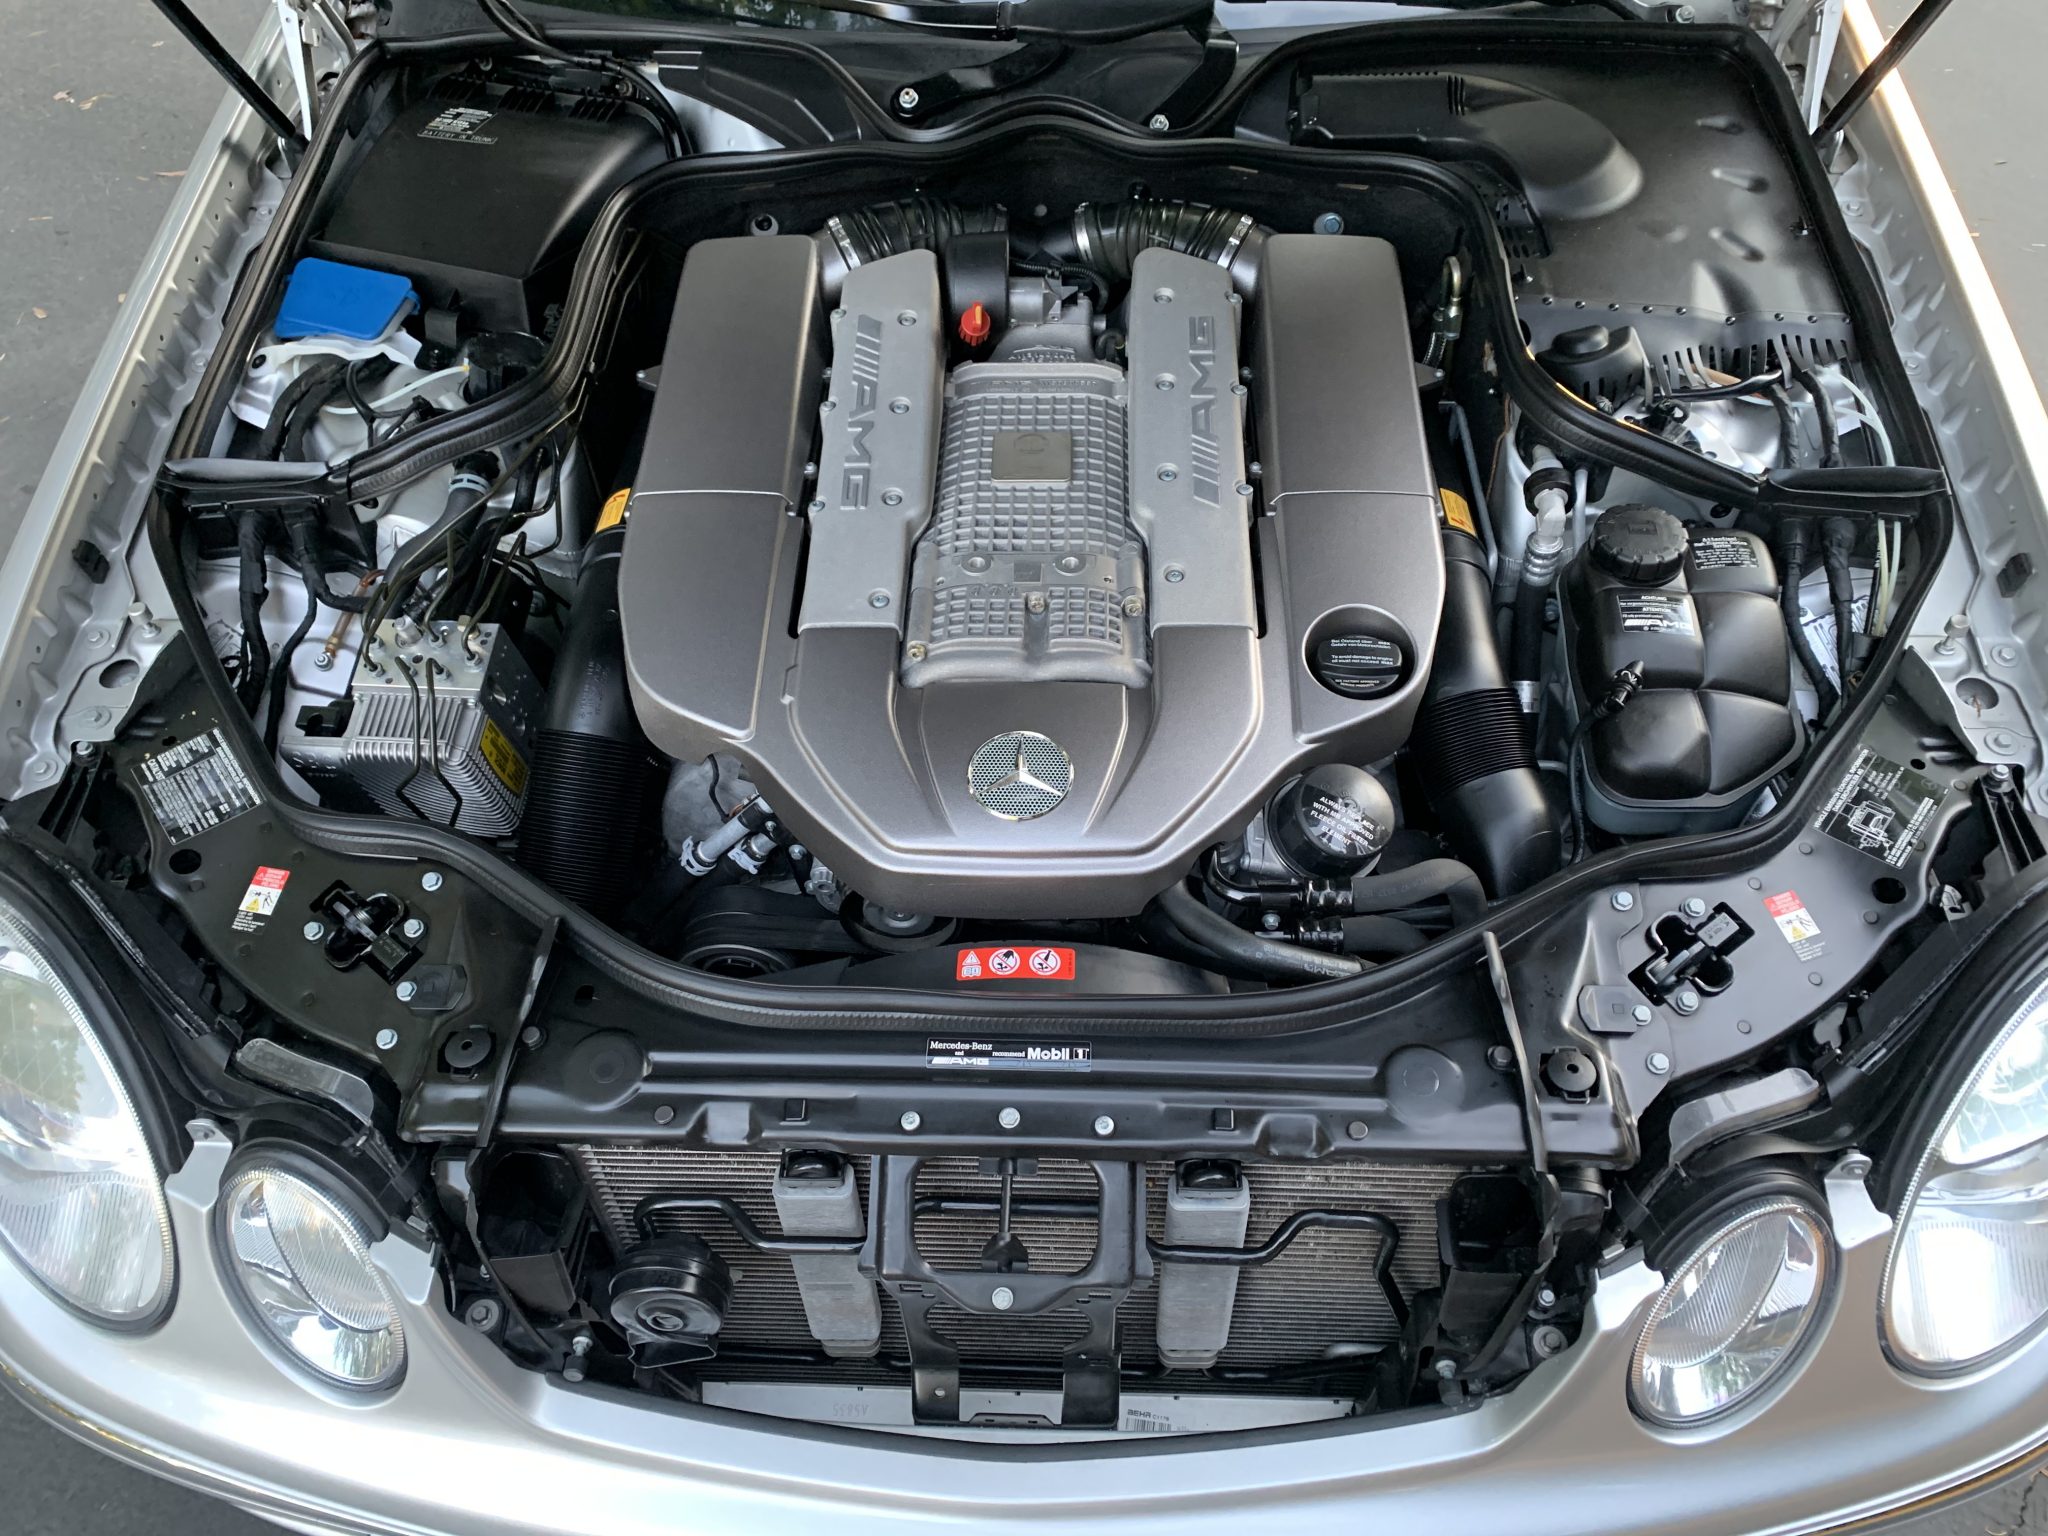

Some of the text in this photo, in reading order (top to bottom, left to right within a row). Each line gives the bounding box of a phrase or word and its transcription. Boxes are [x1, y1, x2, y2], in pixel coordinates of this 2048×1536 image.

[1189, 315, 1219, 447] AMG
[840, 374, 879, 510] AMG
[1313, 801, 1374, 840] WITH MB APPROVED
[1320, 796, 1375, 831] ALWAYS REPLACE
[1310, 810, 1369, 847] FLEECE OIL FILTER
[1321, 825, 1352, 846] ELEMENT
[930, 1041, 992, 1051] Mercedes-Benz
[1027, 1047, 1070, 1060] Mobil
[1073, 1048, 1087, 1060] 1
[946, 1057, 990, 1066] AMG
[1127, 1409, 1151, 1418] BEHR
